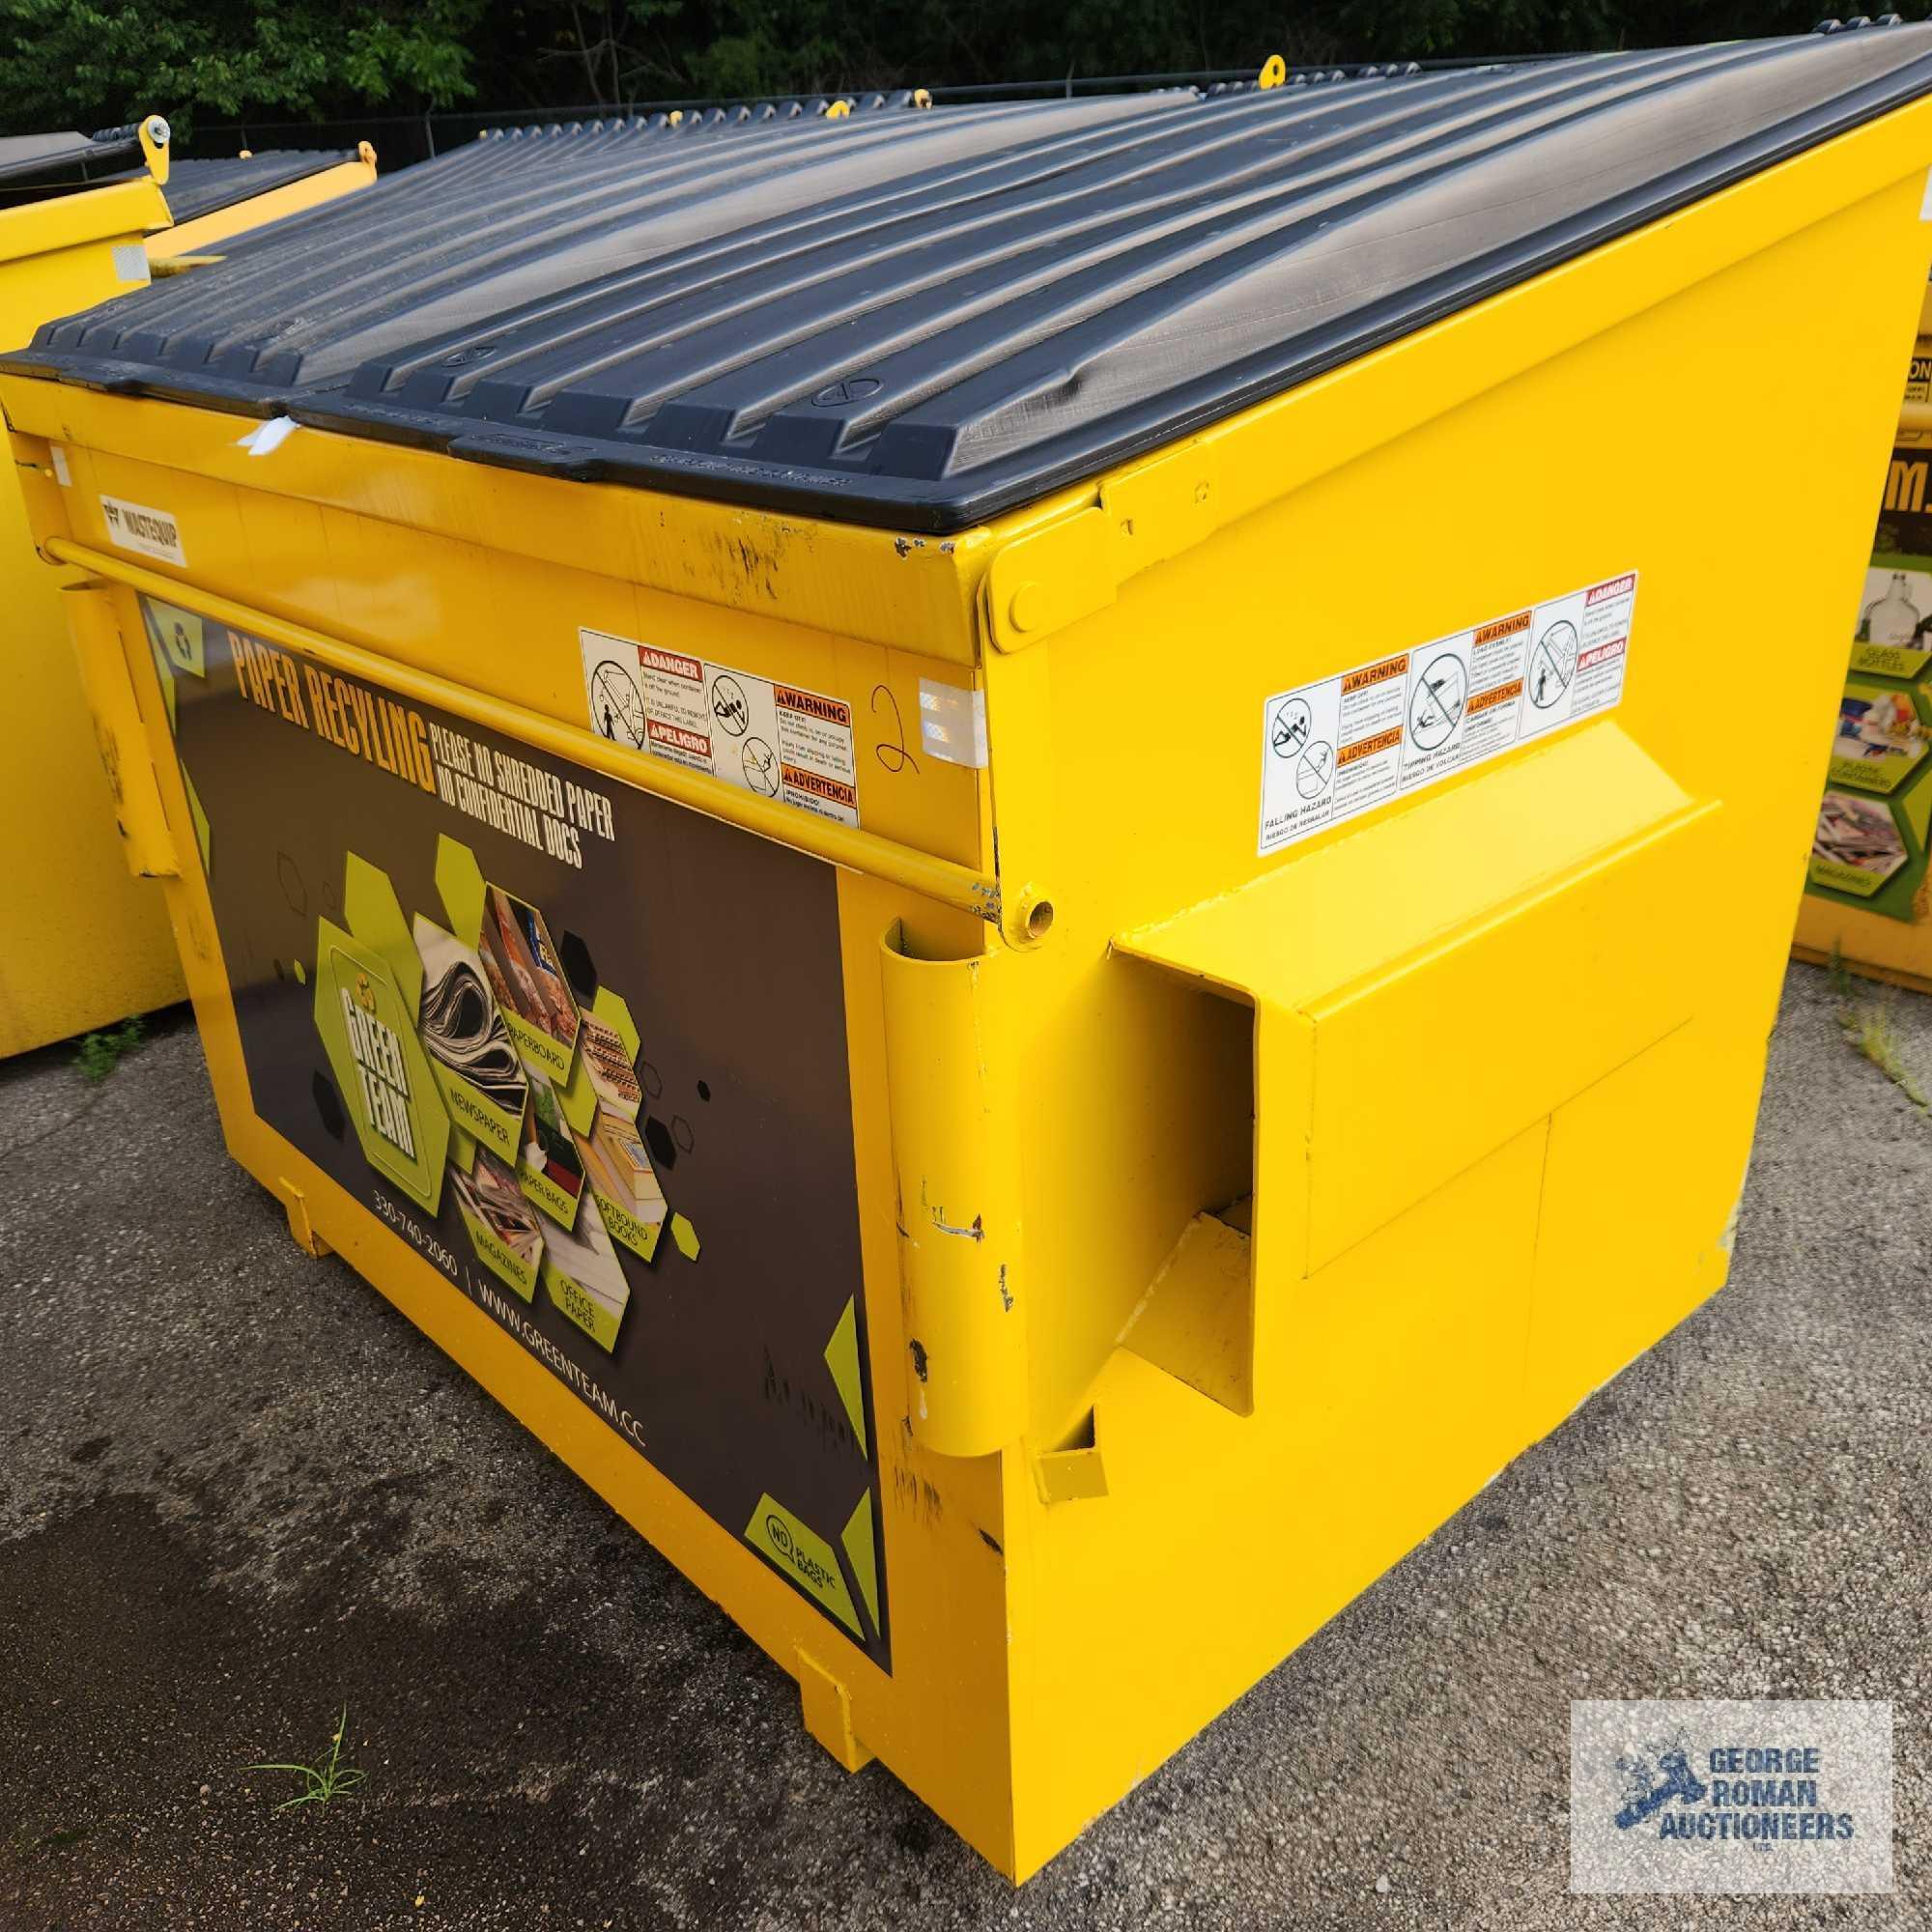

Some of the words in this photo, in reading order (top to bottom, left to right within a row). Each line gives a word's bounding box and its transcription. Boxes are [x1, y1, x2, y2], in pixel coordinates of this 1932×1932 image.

[123, 509, 177, 549] WASTEQUIP
[1595, 579, 1633, 601] DANGER
[1482, 614, 1529, 640] WARNING
[650, 654, 698, 678] DANGER
[1585, 641, 1624, 667] PELIGRO
[1351, 658, 1406, 688] WARNING
[226, 629, 310, 730] PAPER
[303, 664, 437, 795] RECYLING
[785, 691, 846, 723] WARNING
[1476, 682, 1523, 711] ADVERTENCIA
[659, 724, 708, 753] PELIGRO
[1347, 730, 1401, 761] ADVERTENCIA
[428, 721, 476, 779] PLEASE
[470, 741, 495, 787] NO
[494, 750, 565, 819] SHREDDED
[565, 781, 616, 842] PAPER
[793, 773, 855, 806] ADVERTENCIA
[436, 763, 457, 808] NO
[454, 773, 545, 852] CONFIDENTIAL
[542, 813, 583, 869] DOCS
[1264, 810, 1298, 830] FALLING
[1301, 795, 1332, 814] HAZARD
[341, 987, 410, 1099] GREEN
[506, 1021, 565, 1070] PAPERBOARD
[358, 1065, 416, 1161] TEAM
[449, 1088, 511, 1147] NEWSPAPER
[546, 1186, 569, 1214] BAGS
[608, 1215, 639, 1246] BOOKS
[475, 1230, 528, 1286] MAGAZINES
[560, 1278, 595, 1315] OFFICE
[372, 1189, 459, 1276] 330-740-2060
[477, 1278, 647, 1447] WWW.GREENTEAM.CC
[565, 1296, 596, 1334] PAPER
[771, 1522, 789, 1548] NO
[795, 1546, 837, 1589] PLASTIC
[797, 1558, 824, 1589] BAGS
